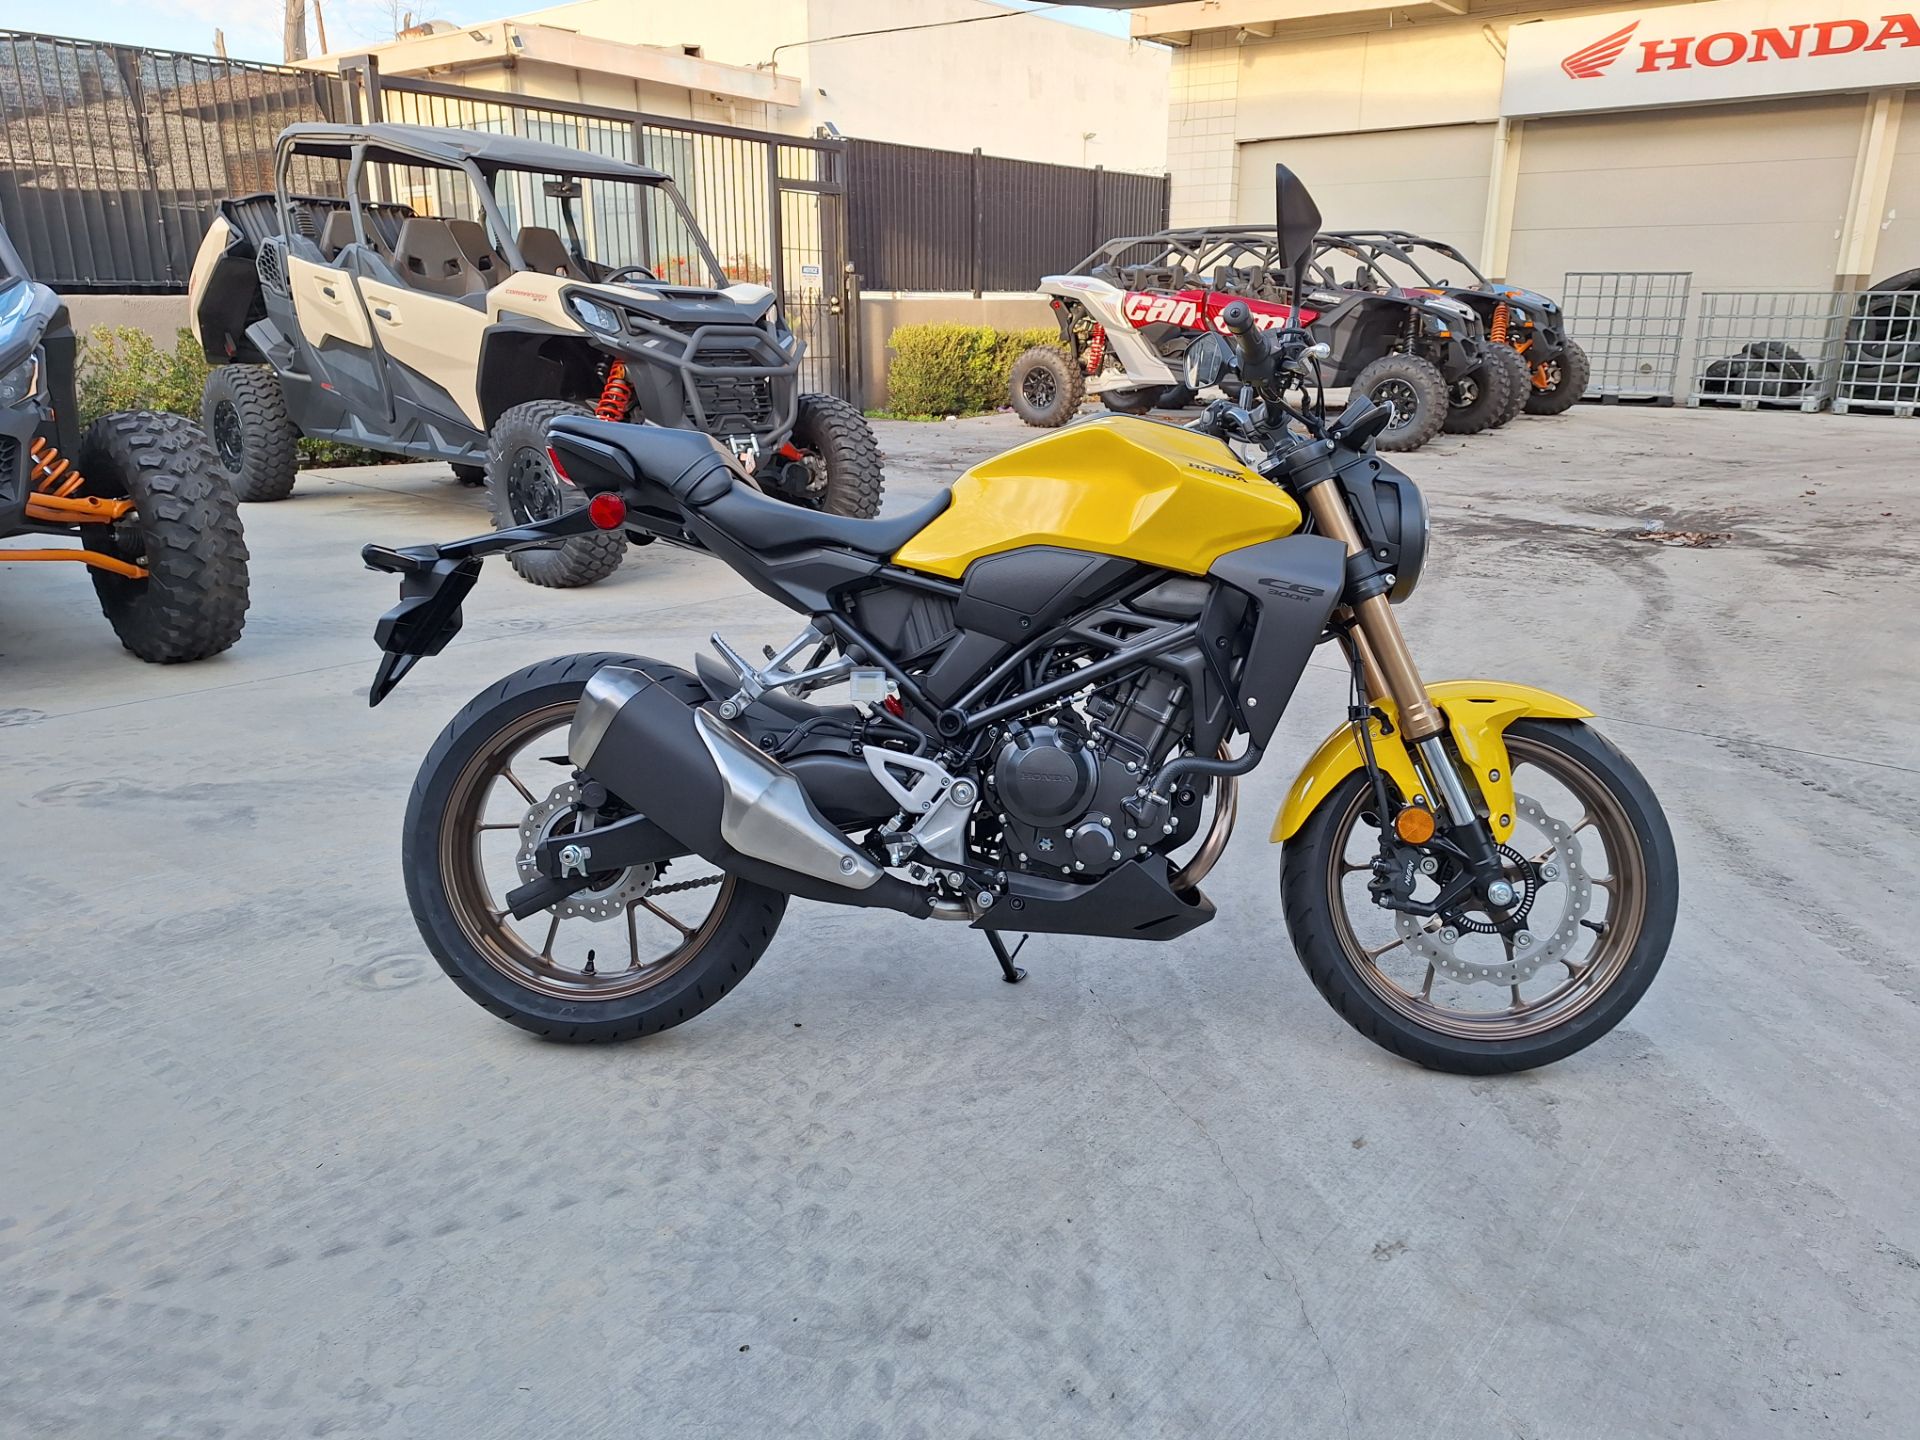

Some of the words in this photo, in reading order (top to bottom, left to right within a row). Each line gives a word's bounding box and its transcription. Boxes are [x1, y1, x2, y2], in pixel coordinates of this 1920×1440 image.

[1636, 13, 1920, 74] HONDA
[1188, 462, 1249, 484] HONDA
[1267, 587, 1312, 603] 300R
[1020, 770, 1073, 783] HONDA
